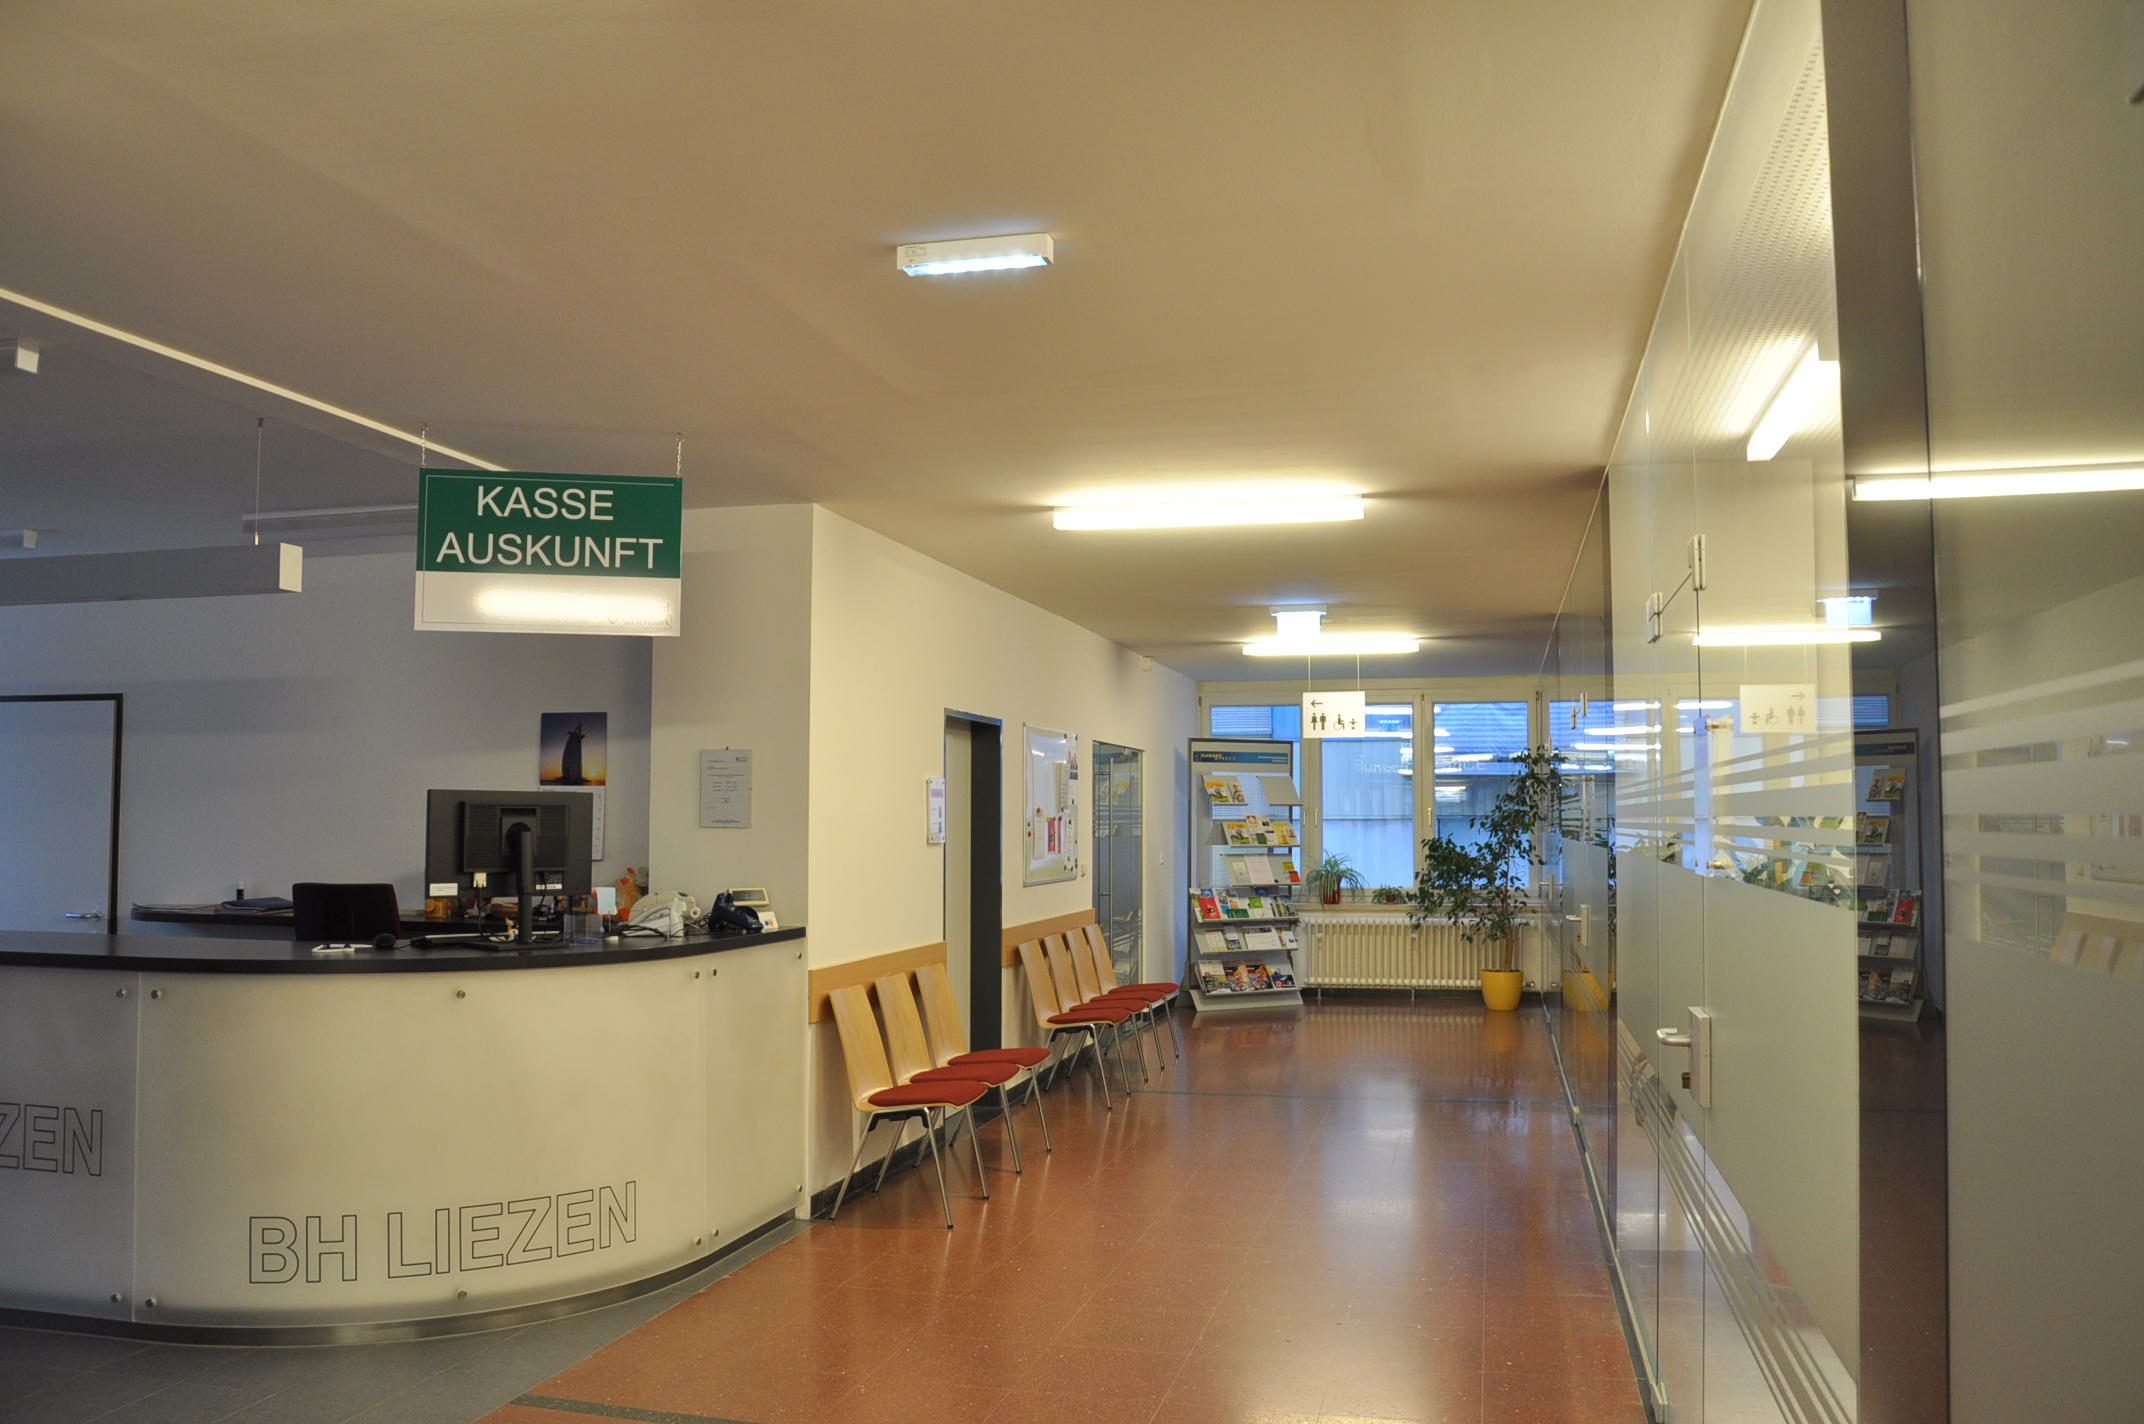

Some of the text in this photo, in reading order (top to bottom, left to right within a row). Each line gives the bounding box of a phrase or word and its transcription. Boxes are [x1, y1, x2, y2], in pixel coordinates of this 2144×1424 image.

[477, 485, 614, 521] KASSE
[436, 532, 664, 569] AUSKUNFT
[248, 1180, 637, 1284] BH LIEZEN
